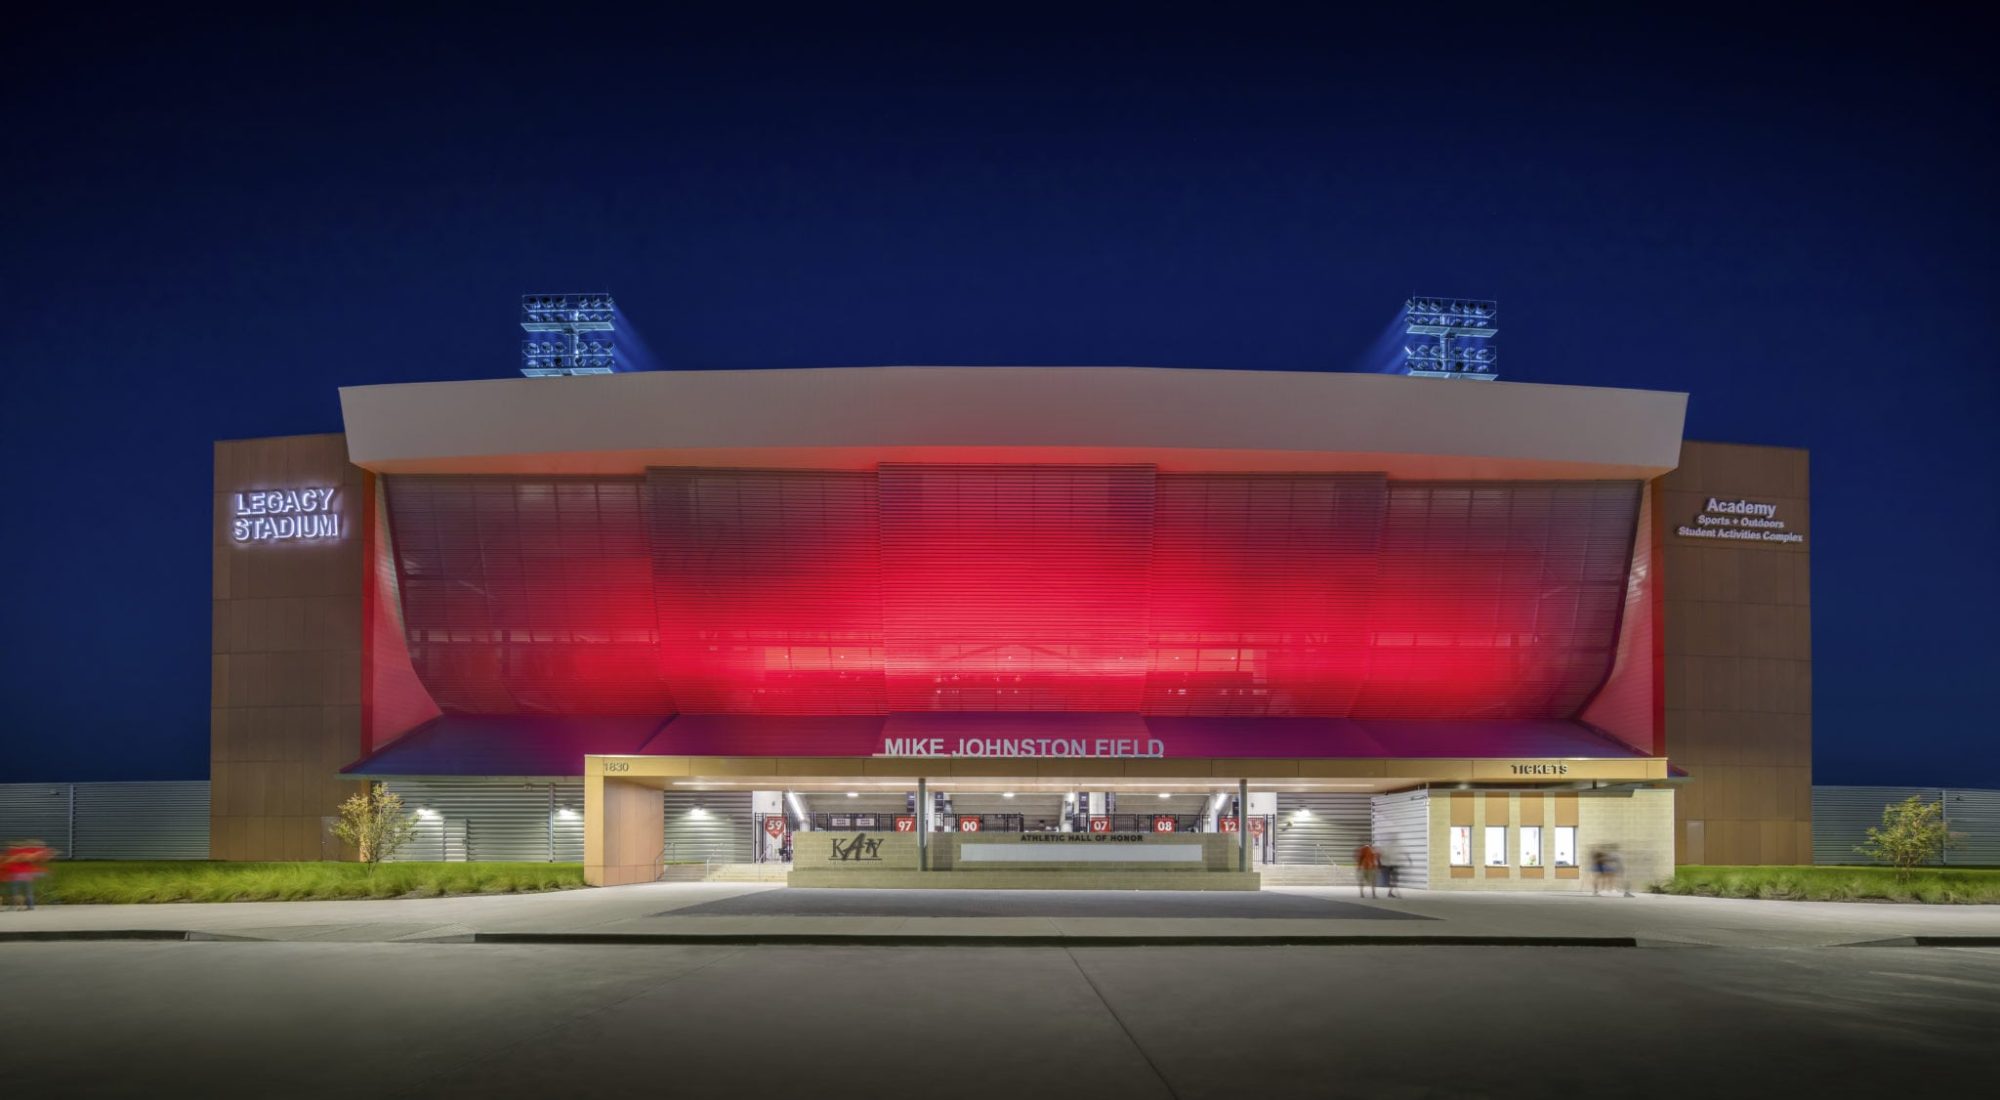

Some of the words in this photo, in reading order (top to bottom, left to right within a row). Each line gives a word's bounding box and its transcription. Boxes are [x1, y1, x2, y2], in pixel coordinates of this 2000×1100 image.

[235, 489, 334, 515] LEGACY
[1706, 498, 1777, 518] Academy
[1698, 515, 1730, 526] Sports
[1740, 517, 1784, 528] Outdoors
[234, 514, 338, 541] STADIUM
[1678, 526, 1716, 537] Student
[1718, 530, 1761, 540] Activities
[1763, 531, 1803, 543] Complex
[884, 738, 945, 756] MIKE
[952, 738, 1086, 757] JOHNSTON
[1095, 739, 1165, 757] FIELD
[603, 762, 629, 772] 1830
[1511, 764, 1568, 775] TICKETS
[768, 820, 782, 830] 59
[899, 821, 912, 831] 97
[963, 821, 976, 831] 00
[1094, 821, 1107, 831] 07
[1158, 821, 1171, 831] 08
[1223, 821, 1237, 831] 12
[1021, 834, 1065, 842] ATHLETIC
[1069, 834, 1092, 842] HALL
[1095, 834, 1107, 842] OF
[1111, 834, 1144, 842] HONOR
